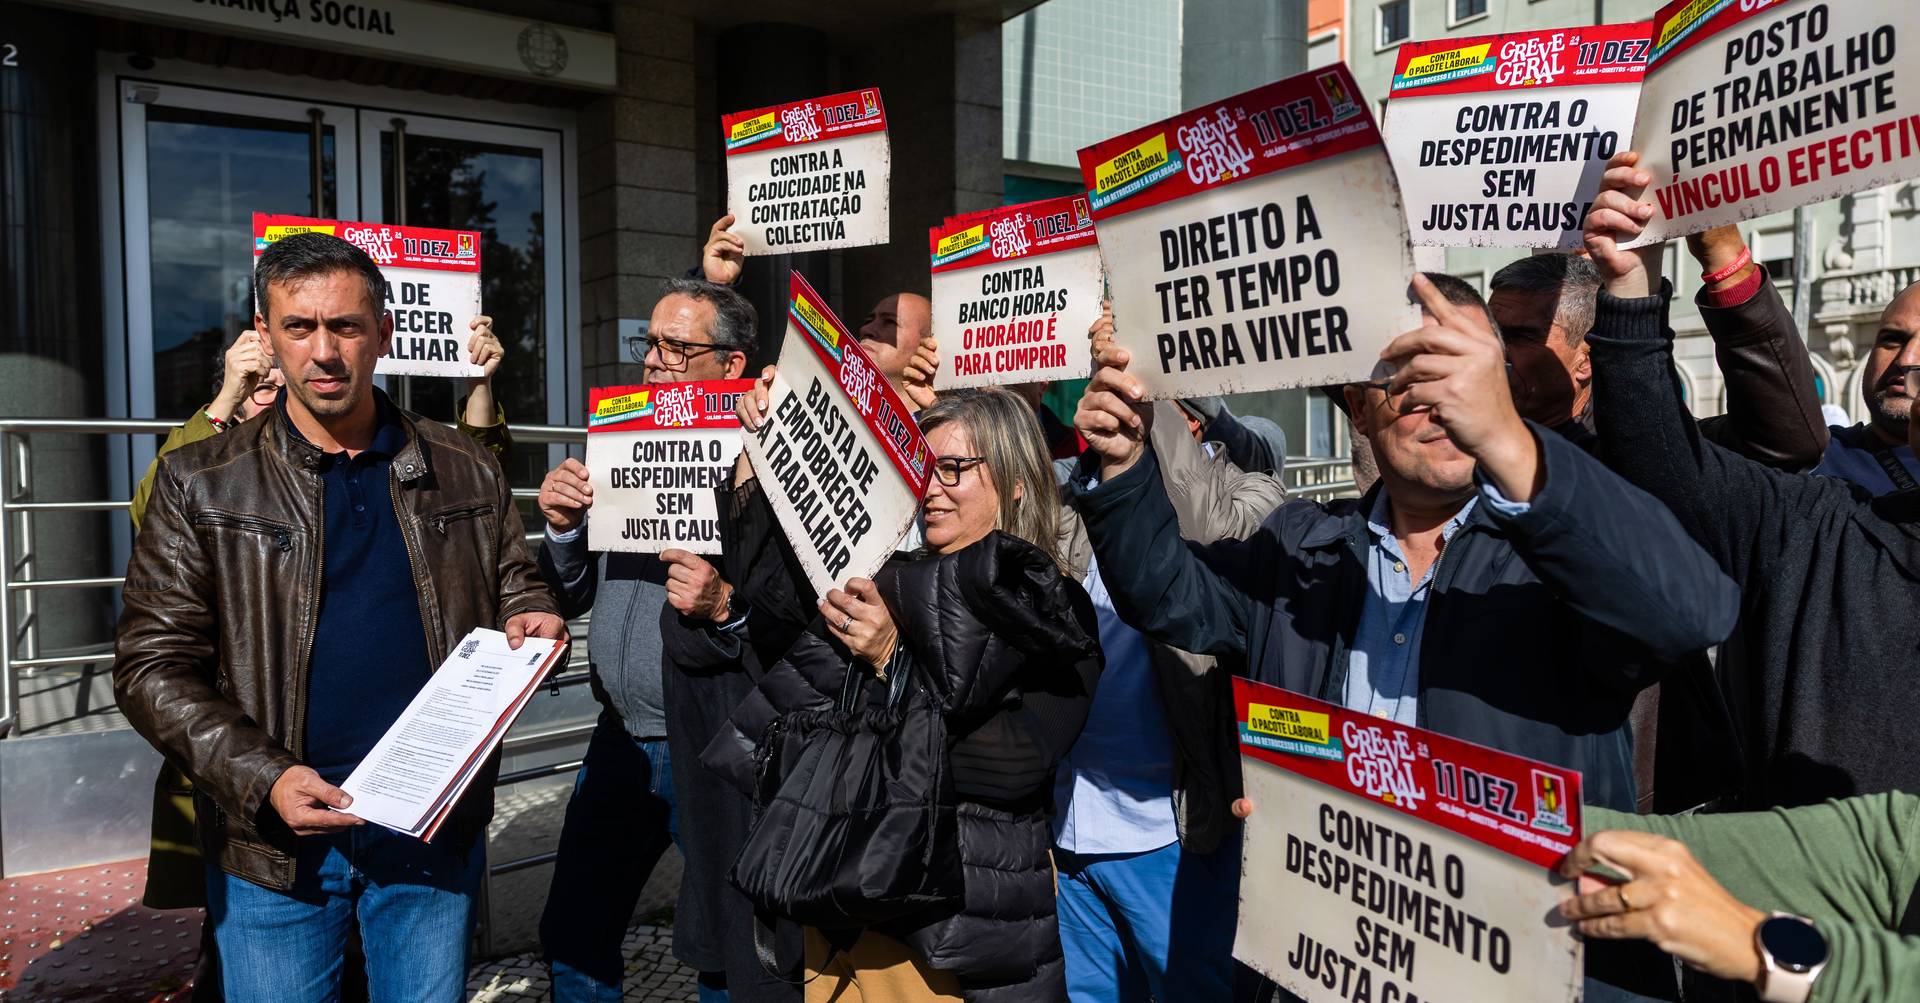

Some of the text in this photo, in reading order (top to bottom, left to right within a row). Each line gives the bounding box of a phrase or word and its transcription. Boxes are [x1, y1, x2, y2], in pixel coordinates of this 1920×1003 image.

[309, 0, 395, 35] SOCIAL
[3, 43, 18, 66] 2
[1501, 33, 1565, 63] GREVE
[1577, 42, 1600, 66] 11
[1725, 4, 1828, 75] POSTO
[1409, 56, 1480, 76] O PACOTE LABORAL
[1430, 51, 1460, 63] CONTRA
[1495, 53, 1565, 86] GERAL
[1671, 91, 1705, 134] DE
[1713, 25, 1895, 118] TRABALHO
[743, 118, 760, 128] CONTRA
[781, 102, 816, 125] GREVE
[823, 107, 834, 125] 11
[836, 103, 863, 123] DEZ.
[1249, 97, 1330, 145] 11 DEZ.
[1456, 99, 1588, 134] CONTRA O
[1671, 71, 1896, 174] PERMANENTE
[738, 127, 753, 138] PACOTE
[753, 122, 772, 132] LABORAL
[784, 117, 821, 142] GERAL
[1177, 106, 1237, 153] GREVE
[770, 149, 843, 177] CONTRA A
[1114, 149, 1142, 170] CONTRA
[1186, 133, 1254, 185] GERAL
[1419, 131, 1618, 167] DESPEDIMENTO
[1100, 151, 1165, 190] O PACOTE LABORAL
[1482, 169, 1536, 198] SEM
[748, 170, 866, 202] CADUCIDADE NA
[1656, 156, 1780, 220] VÍNCULO
[751, 191, 861, 225] CONTRATAÇÃO
[1422, 203, 1500, 231] JUSTA
[344, 228, 392, 245] GREVE
[765, 220, 846, 246] COLECTIVA
[950, 232, 968, 243] CONTRA
[990, 213, 1025, 239] GREVE
[1034, 212, 1075, 238] 11 DEZ.
[1160, 194, 1322, 272] DIREITO A
[350, 242, 398, 264] RAL
[403, 238, 454, 258] 11 DEZ.
[944, 243, 959, 253] PACOTE
[961, 235, 981, 248] LABORAL
[992, 229, 1031, 259] GERAL
[401, 282, 430, 306] DE
[982, 265, 1044, 296] CONTRA
[1155, 248, 1340, 324] TER TEMPO
[808, 305, 825, 326] CONTRA
[959, 289, 1068, 325] BANCO HORAS
[801, 307, 818, 328] PACOTE
[816, 321, 835, 346] LABORAL
[963, 312, 1057, 350] O HORÁRIO É
[1157, 305, 1353, 374] PARA VIVER
[844, 344, 876, 391] GREVE
[955, 344, 1066, 376] PARA CUMPRIR
[612, 396, 631, 406] CONTRA
[656, 384, 695, 408] GREVE
[705, 393, 746, 413] 11 DE
[839, 362, 874, 417] GERAL
[603, 405, 621, 415] PACOTE
[622, 401, 645, 411] LABORAL
[654, 402, 698, 427] GERAL
[805, 375, 853, 464] BASTA
[851, 445, 879, 497] DE
[877, 397, 912, 459] 11 DEZ.
[633, 440, 722, 463] CONTRA O
[776, 389, 873, 548] EMPOBRECER
[656, 493, 693, 515] SEM
[757, 416, 851, 582] A TRABALHAR
[622, 519, 670, 541] JUSTA
[1252, 718, 1325, 741] O PACOTE LABORAL
[1269, 708, 1301, 723] CONTRA
[1342, 721, 1416, 770] GREVE
[1347, 752, 1426, 810] GERAL
[1432, 759, 1528, 825] 11 DEZ.
[1319, 803, 1437, 889] CONTRA
[1444, 853, 1464, 901] O
[1286, 833, 1512, 975] DESPEDIMENTO
[1354, 915, 1416, 982] SEM
[1288, 932, 1371, 1003] JUSTA
